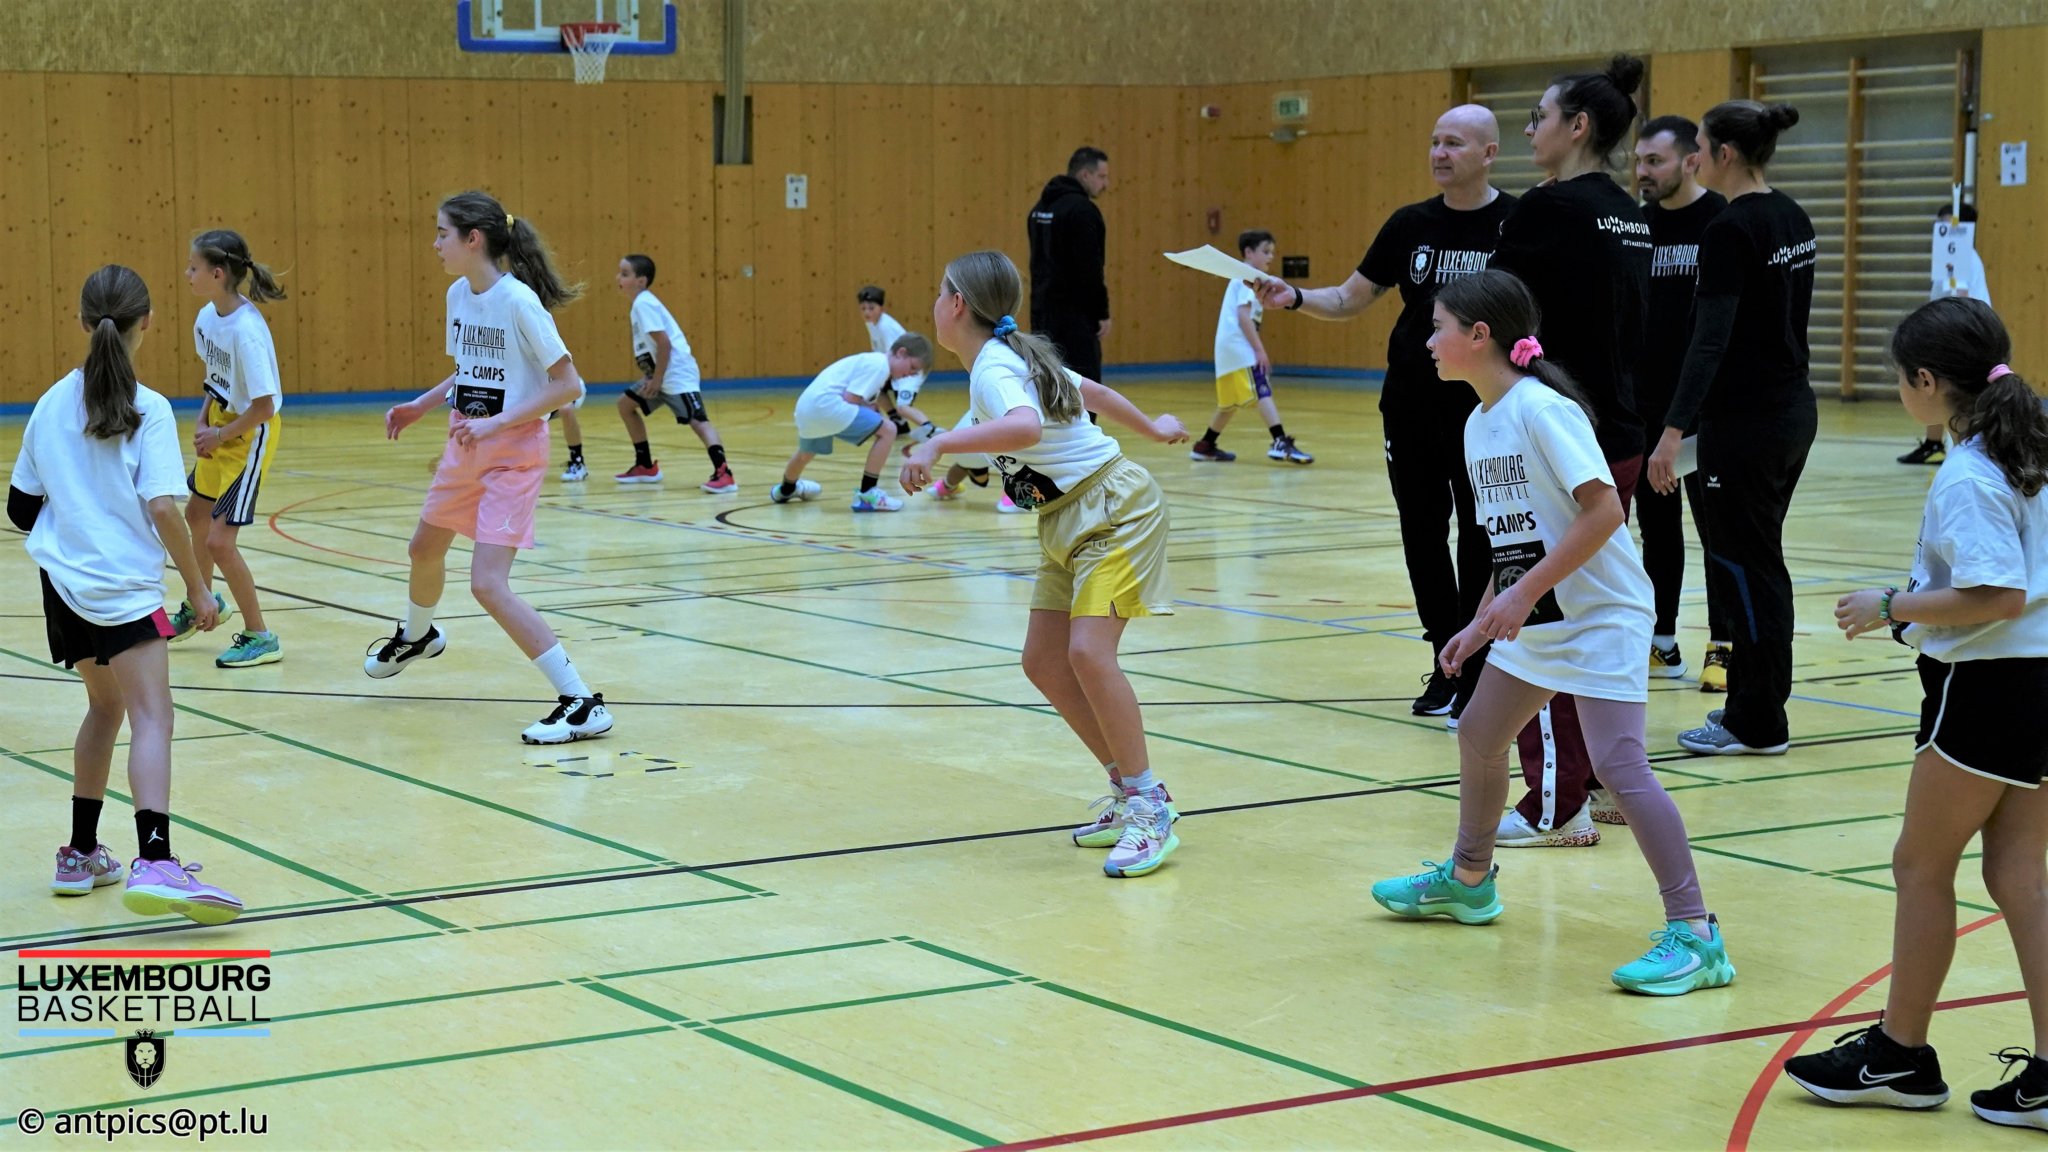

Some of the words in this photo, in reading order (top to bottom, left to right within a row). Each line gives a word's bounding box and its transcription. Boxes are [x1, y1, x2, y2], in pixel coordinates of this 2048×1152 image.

[1597, 215, 1650, 235] LUXEMBOUR
[1437, 249, 1489, 272] LUXEMBOU
[463, 324, 505, 347] LUXMBOURG
[472, 365, 505, 382] CAMPS
[1475, 454, 1526, 485] UXEMBOURG
[1487, 511, 1537, 536] CAMPS
